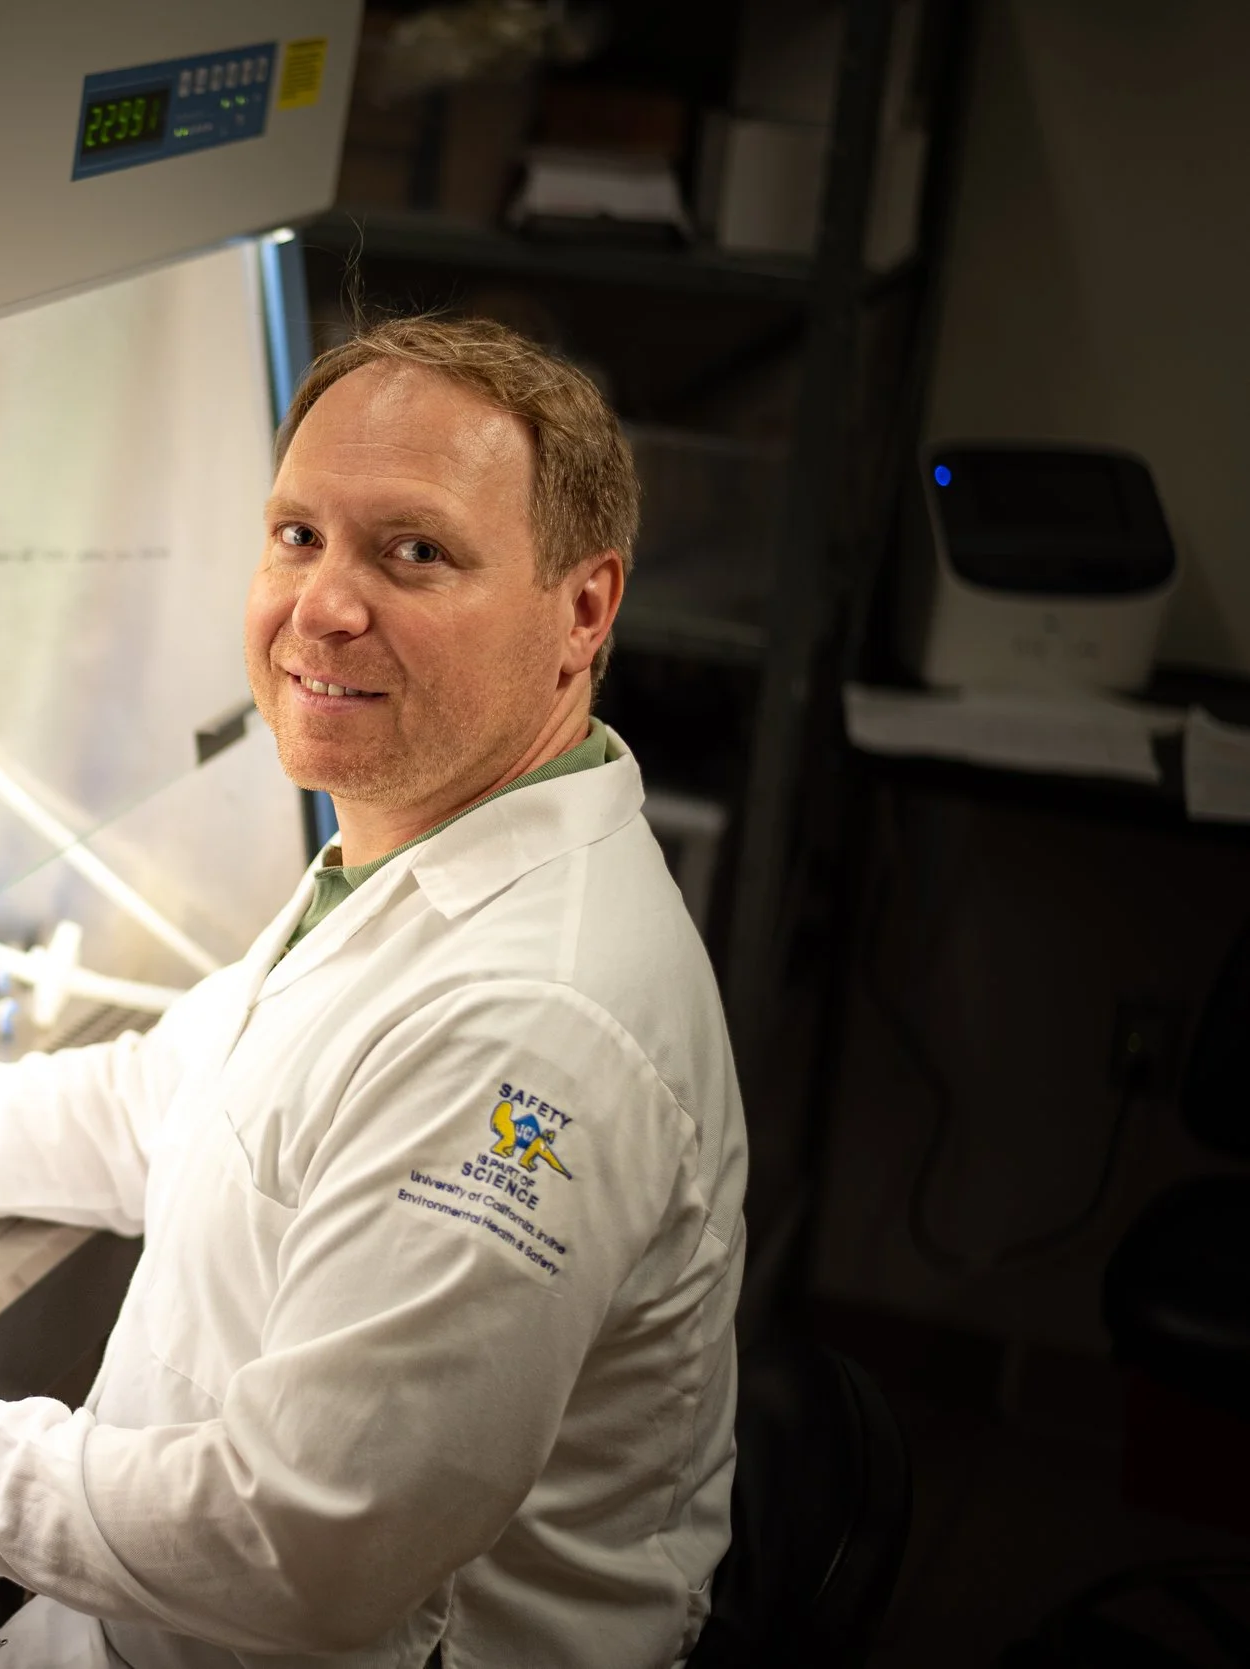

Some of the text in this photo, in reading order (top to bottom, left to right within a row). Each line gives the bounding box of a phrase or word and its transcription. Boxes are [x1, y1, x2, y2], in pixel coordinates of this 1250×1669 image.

[498, 1082, 573, 1130] SAFETY
[461, 1162, 540, 1211] SCIENCE
[476, 1153, 537, 1189] IS PART OF
[410, 1169, 467, 1200] University
[468, 1191, 483, 1203] of
[482, 1195, 535, 1237] California,
[397, 1188, 560, 1276] Environmental Health & Safety
